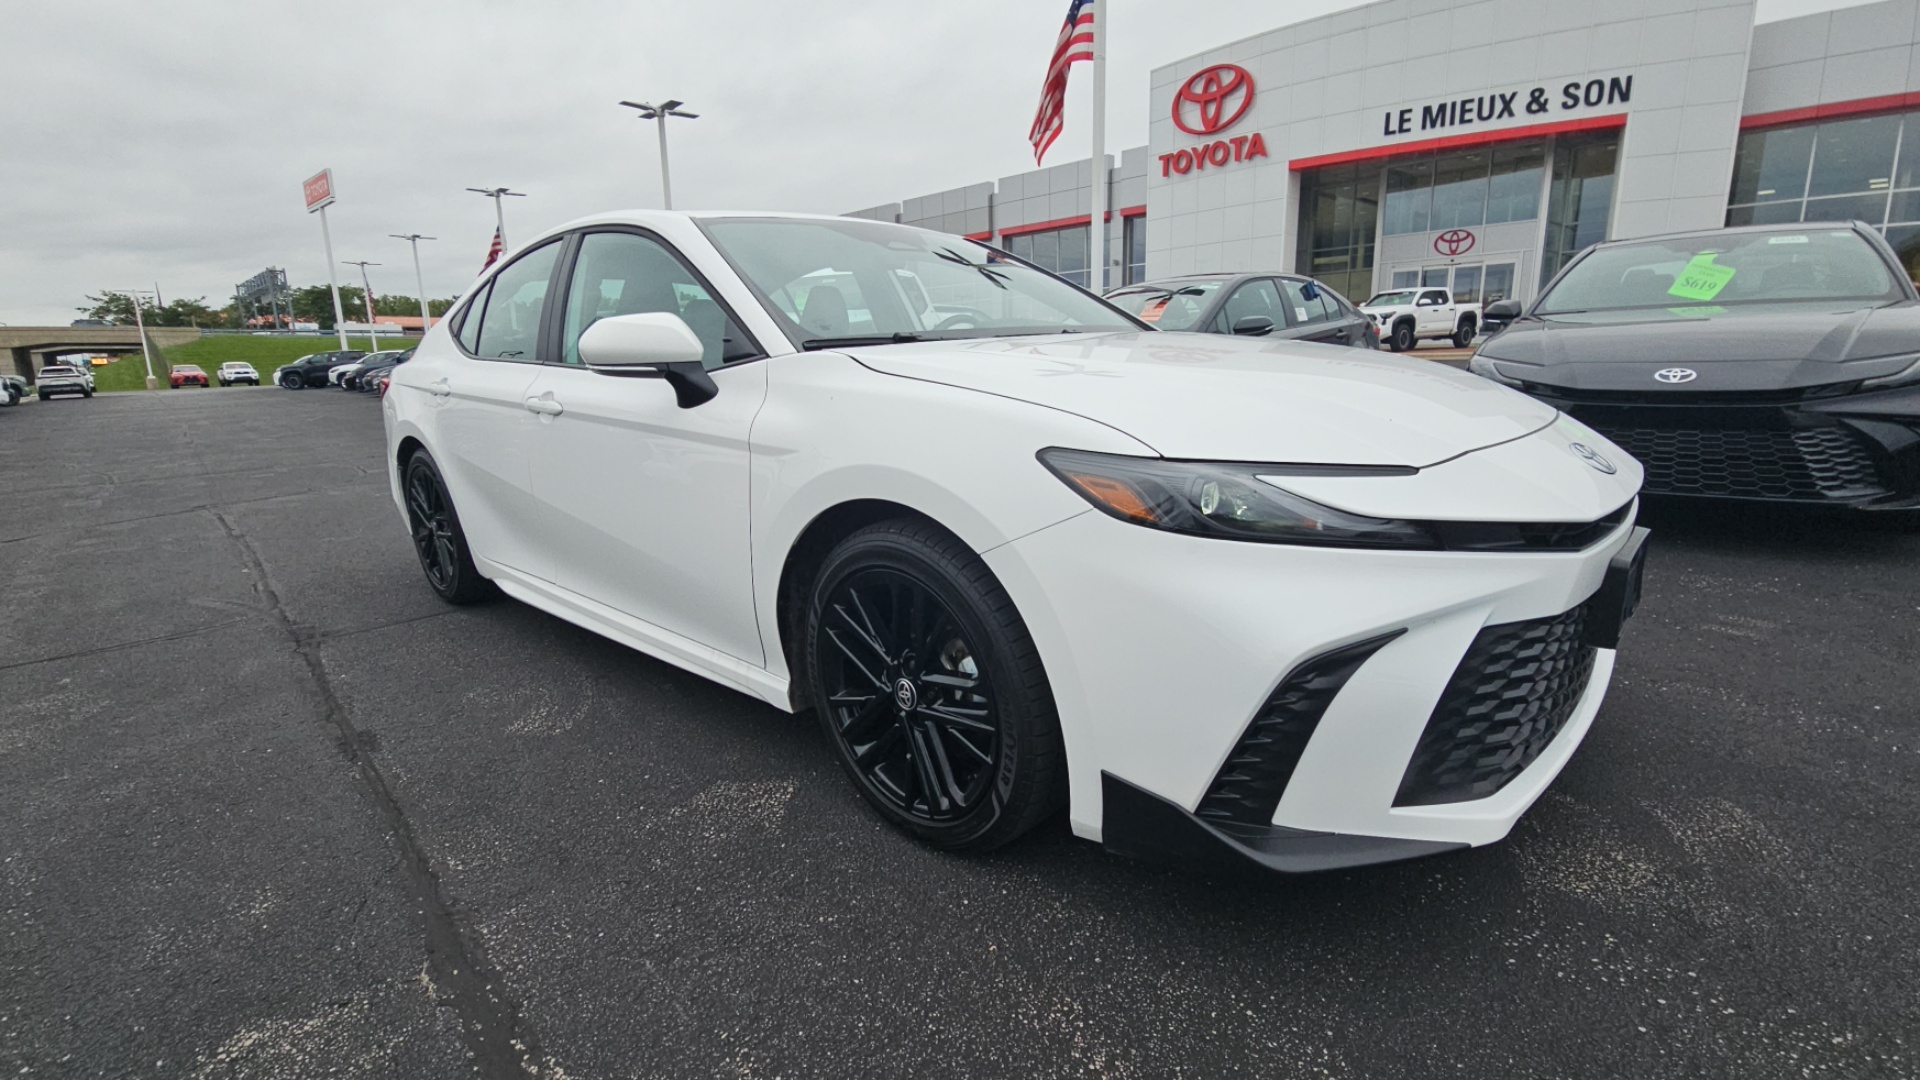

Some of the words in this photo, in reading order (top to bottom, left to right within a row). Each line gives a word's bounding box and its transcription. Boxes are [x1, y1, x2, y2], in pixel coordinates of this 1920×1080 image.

[1383, 108, 1413, 136] LE
[1421, 91, 1519, 130] MIEUX
[1525, 87, 1549, 114] &
[1561, 75, 1633, 110] SON
[1158, 132, 1268, 178] TOYOTA
